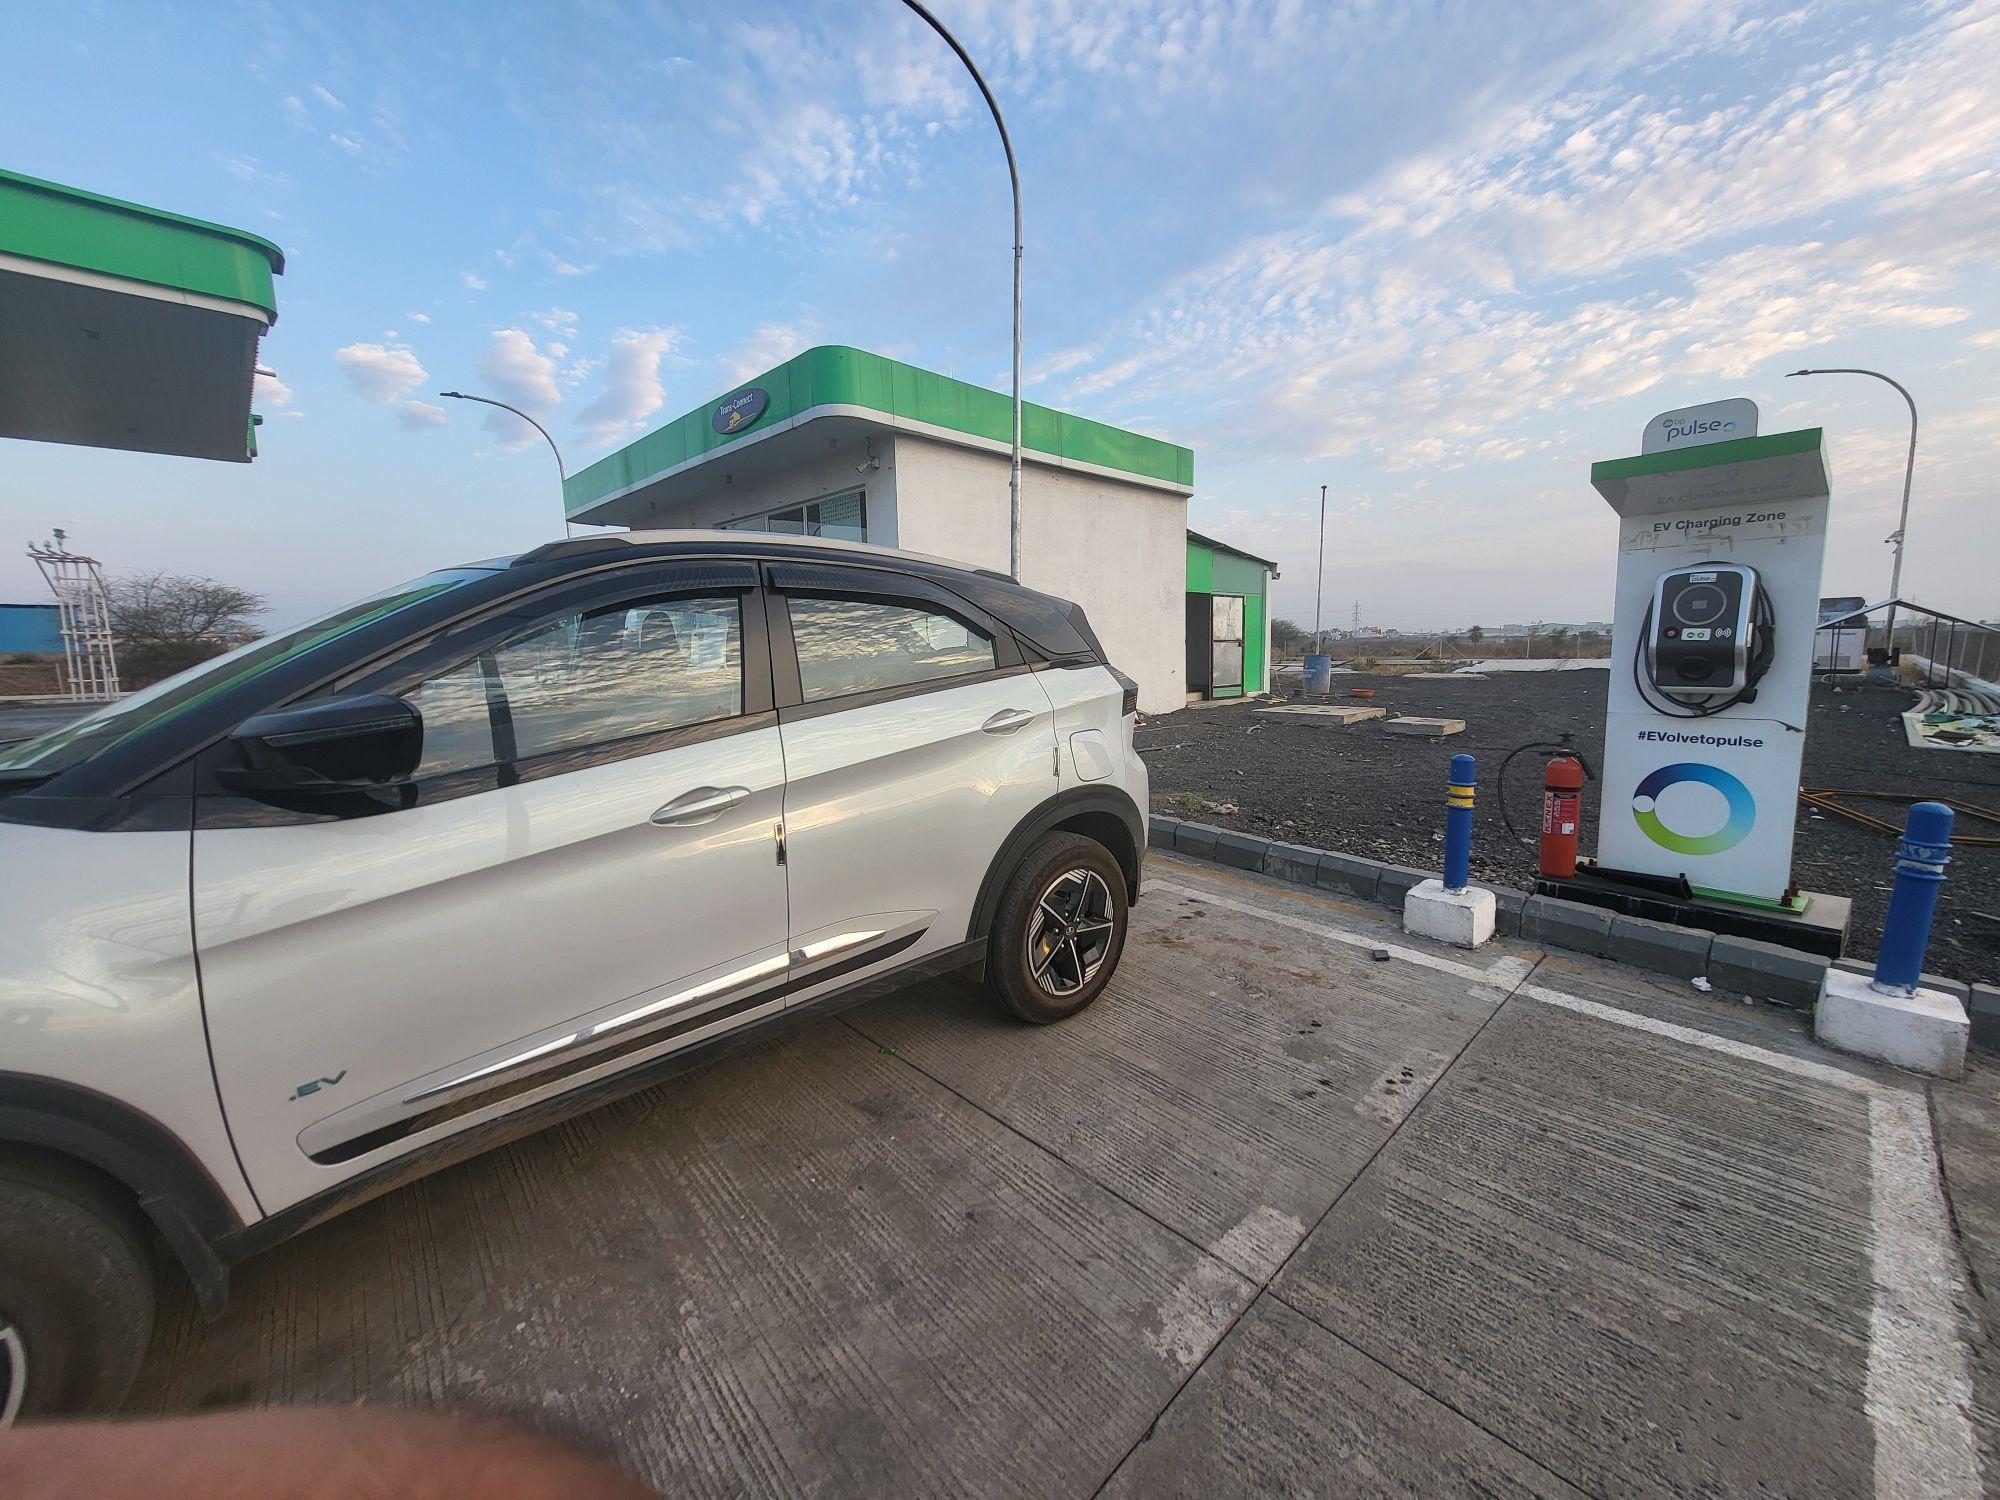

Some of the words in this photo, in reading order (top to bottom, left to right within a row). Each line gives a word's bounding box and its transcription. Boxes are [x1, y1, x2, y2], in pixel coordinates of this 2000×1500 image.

[719, 393, 753, 416] Trans-Connect
[1666, 419, 1722, 443] pulse
[1653, 522, 1672, 533] EV
[1675, 515, 1742, 530] Charging
[1746, 512, 1786, 524] Zone
[1637, 730, 1764, 748] #EVolvetopulse
